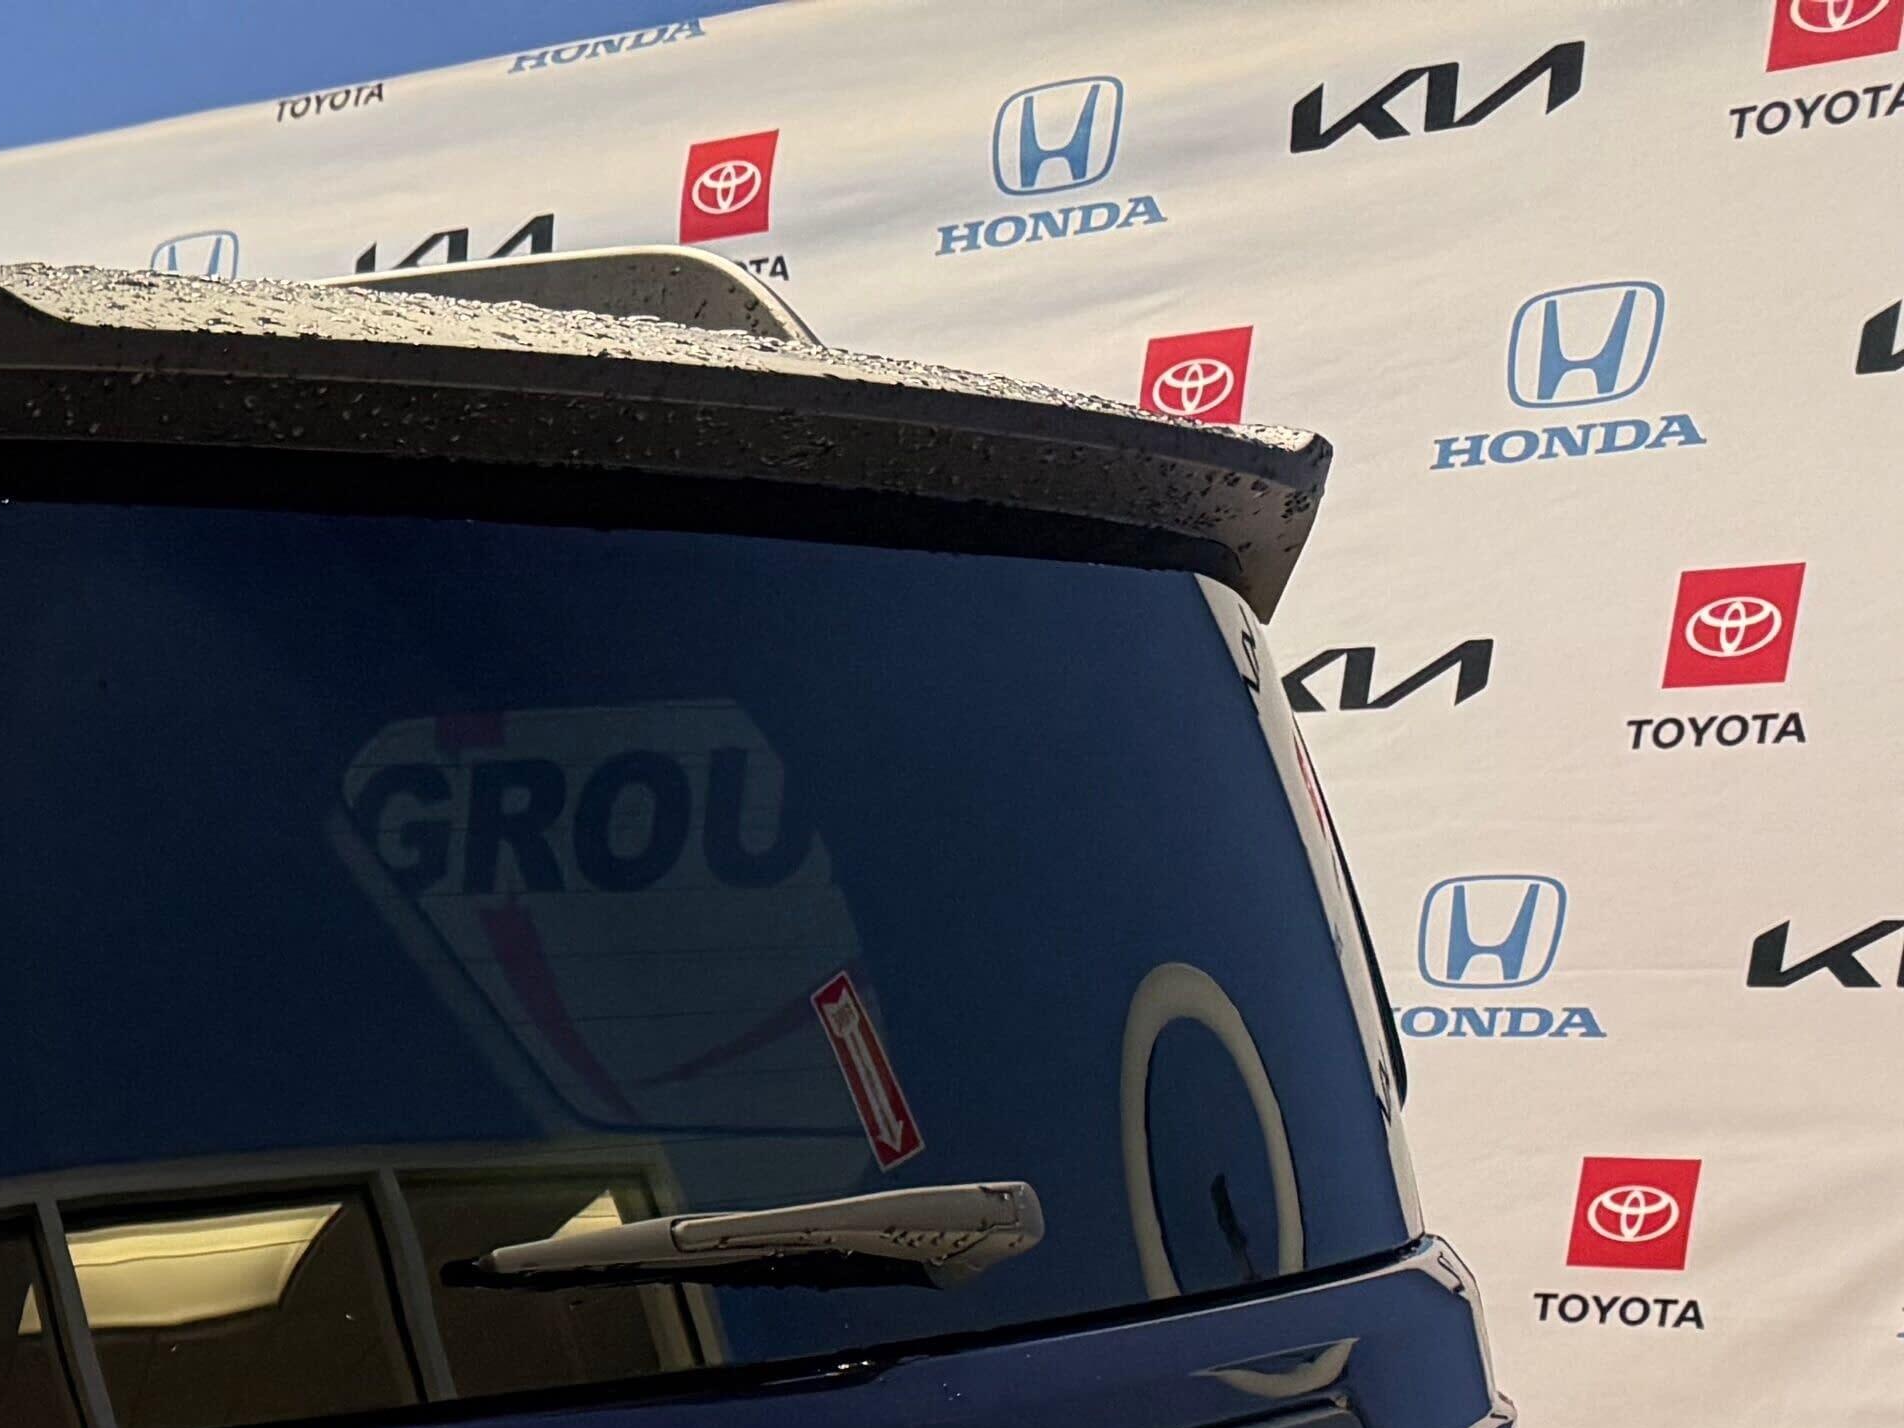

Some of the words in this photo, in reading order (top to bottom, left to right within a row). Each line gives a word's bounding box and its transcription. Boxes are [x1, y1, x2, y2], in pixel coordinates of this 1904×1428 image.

[277, 83, 385, 123] TOYOTA
[1290, 40, 1586, 154] KIA
[936, 196, 1166, 256] HONDA
[1430, 414, 1707, 471] HONDA
[1626, 711, 1807, 750] TOYOTA
[1392, 1006, 1607, 1039] ONDA
[1533, 1292, 1705, 1330] TOYOTA
